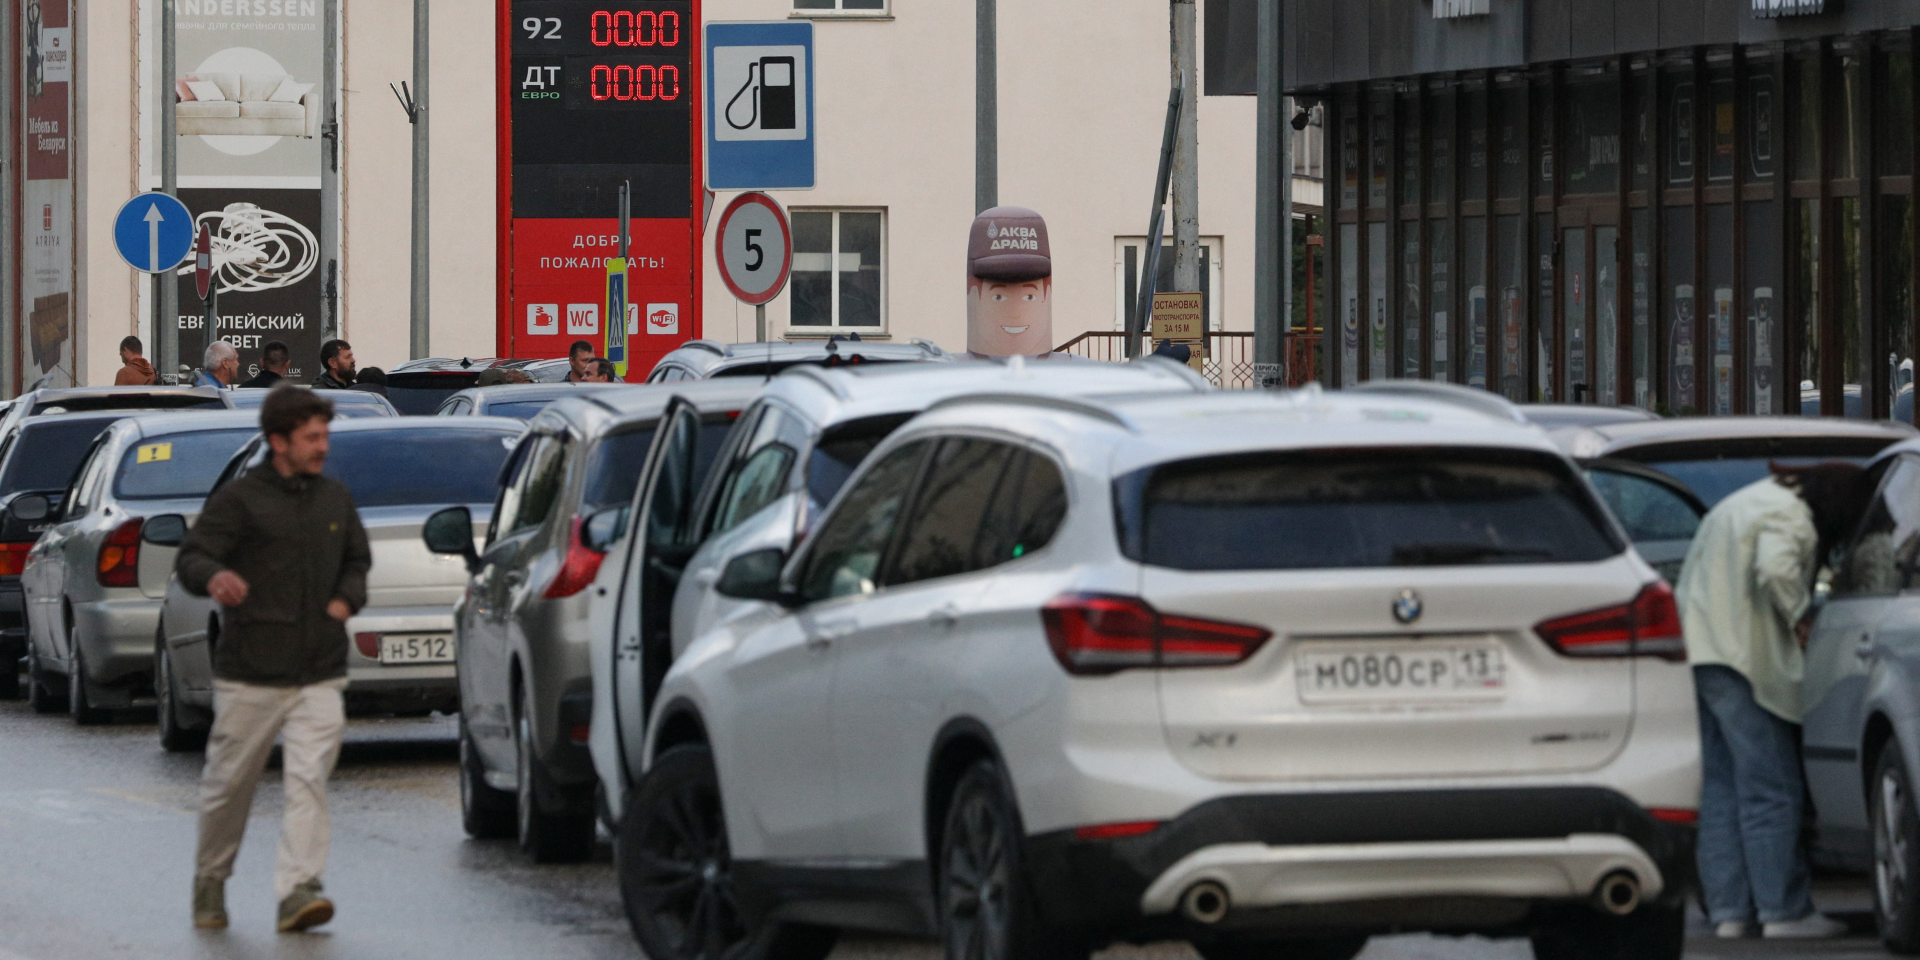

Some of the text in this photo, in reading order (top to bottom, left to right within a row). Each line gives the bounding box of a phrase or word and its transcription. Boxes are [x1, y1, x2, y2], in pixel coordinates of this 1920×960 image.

[175, 20, 316, 31] иваны для семейного тепла
[522, 10, 679, 47] 92 00.00
[522, 65, 679, 101] ДТ 00.00
[29, 116, 59, 134] Мебель из
[38, 135, 66, 155] Беларуси
[999, 227, 1038, 238] АКВА
[35, 235, 60, 247] ATRIYA
[573, 235, 632, 248] ДОБР
[990, 237, 1038, 250] ДРАЙВ
[744, 228, 763, 272] 5
[540, 257, 665, 268] ПОЖАЛАТЬ!
[1154, 300, 1199, 310] ОСТАНОВКА
[570, 310, 593, 327] WC
[1164, 324, 1190, 333] ЗА 15 М
[1459, 651, 1490, 678] 13
